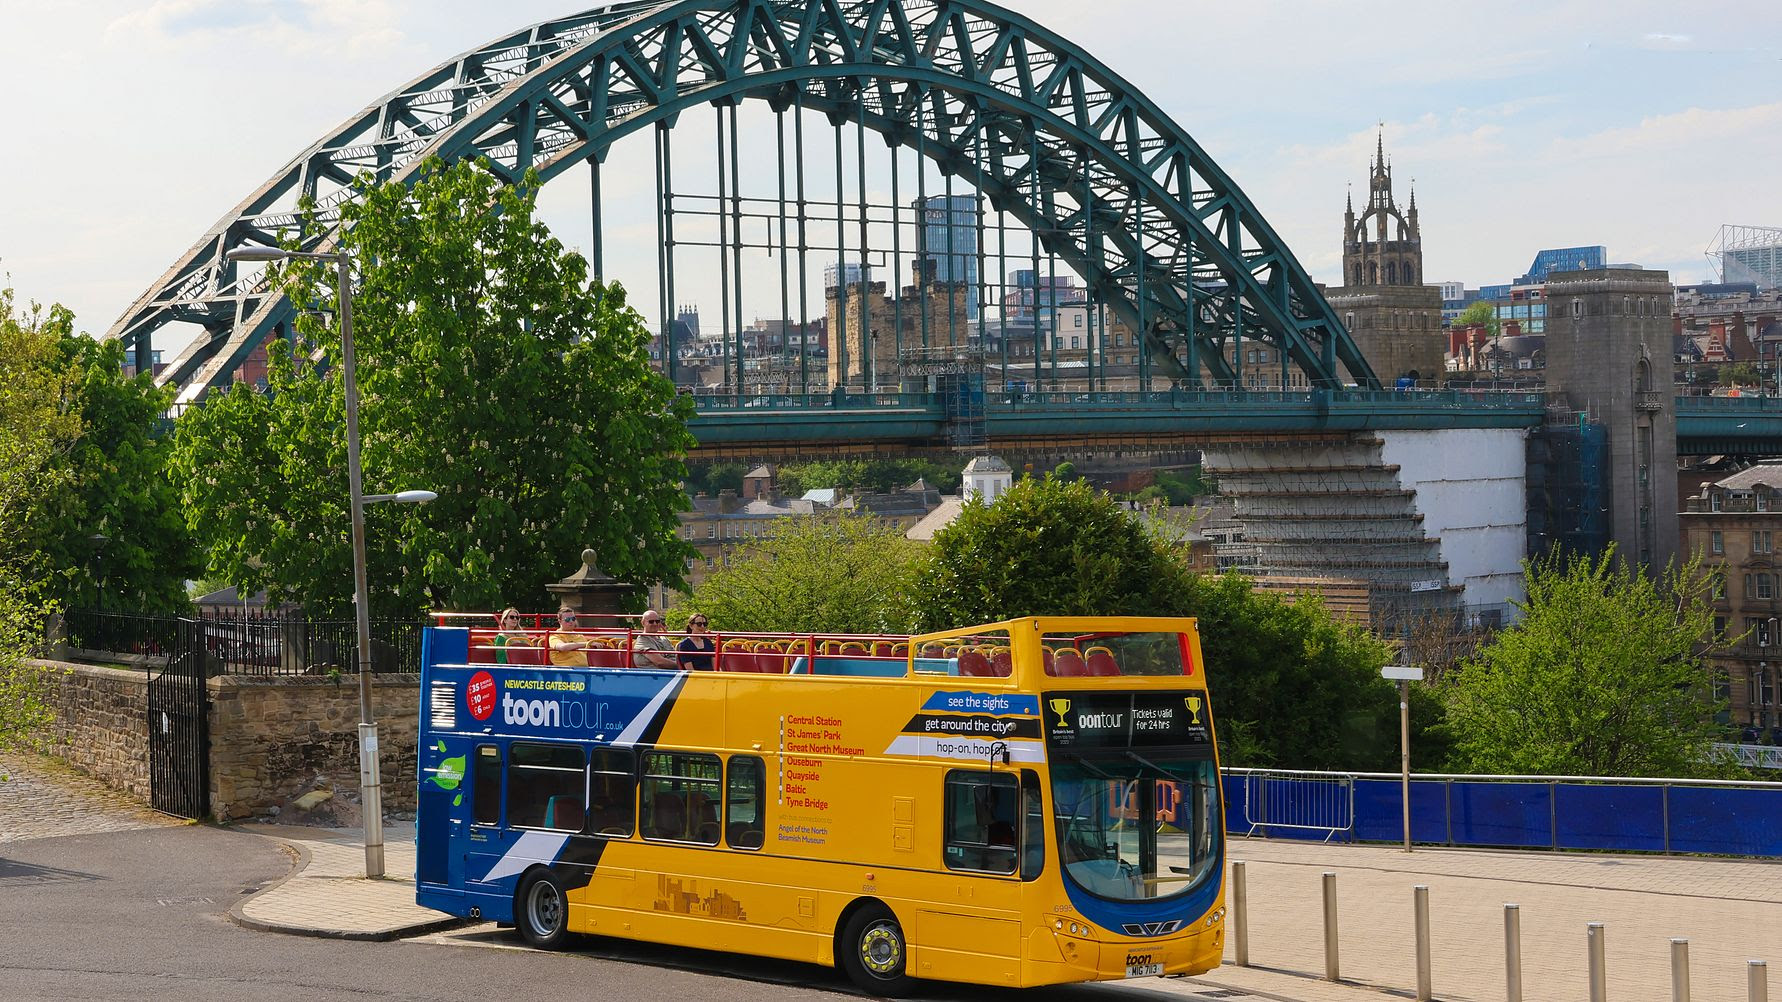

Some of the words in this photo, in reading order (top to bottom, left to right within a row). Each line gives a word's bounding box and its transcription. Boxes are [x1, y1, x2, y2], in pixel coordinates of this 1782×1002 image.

[504, 680, 544, 690] NEWCASTLE
[546, 680, 585, 691] GATESHEAD
[471, 694, 482, 706] £10
[948, 698, 964, 706] see
[966, 696, 980, 707] the
[982, 697, 1008, 710] sights
[474, 705, 482, 716] £6
[1132, 709, 1156, 718] Tickets
[1158, 708, 1172, 718] valid
[788, 714, 814, 725] Central
[816, 716, 842, 726] Station
[1136, 720, 1148, 730] for
[1149, 720, 1158, 729] 24
[1158, 719, 1170, 728] hrs
[925, 720, 940, 731] get
[940, 719, 973, 732] around
[974, 720, 990, 732] the
[991, 720, 1008, 734] city
[788, 728, 796, 738] St
[797, 728, 822, 739] James'
[824, 730, 841, 740] Park
[788, 742, 808, 752] Great
[810, 744, 832, 754] North
[833, 745, 864, 756] Museum
[937, 741, 972, 755] hop-on,
[787, 756, 822, 767] Ouseburn
[786, 770, 820, 782] Quayside
[786, 784, 806, 794] Baltic
[786, 796, 803, 808] Tyne
[804, 798, 828, 810] Bridge
[778, 824, 794, 833] Angel
[778, 833, 800, 842] Beamish
[802, 836, 826, 844] Museum
[1132, 966, 1144, 976] MIG
[1145, 964, 1158, 974] 7113
